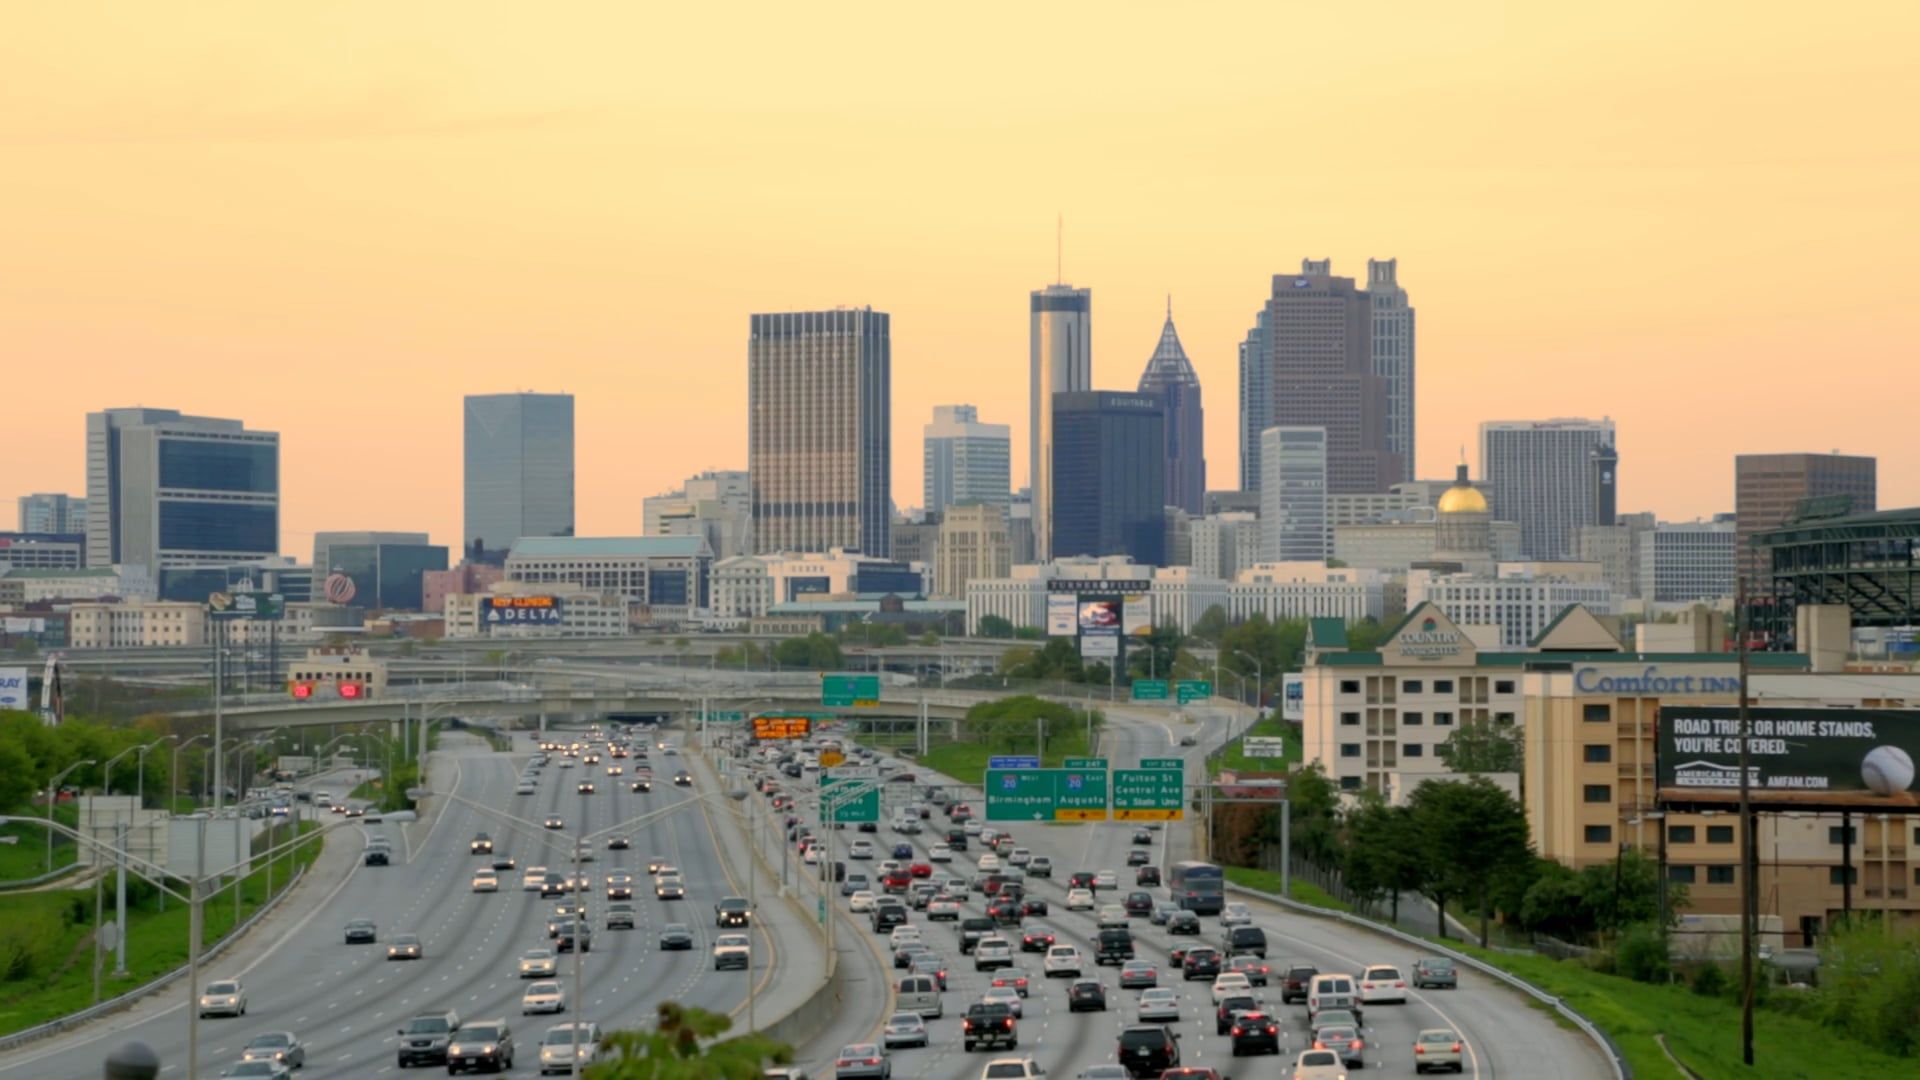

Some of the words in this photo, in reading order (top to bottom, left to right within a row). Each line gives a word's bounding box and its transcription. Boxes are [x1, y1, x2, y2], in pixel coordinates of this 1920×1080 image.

[1051, 581, 1099, 590] TURNER
[1110, 581, 1147, 590] FIELD
[504, 608, 560, 620] DELTA
[1400, 631, 1460, 643] COUNTRY
[1575, 665, 1695, 693] Comfort
[1701, 676, 1742, 692] INN
[1674, 719, 1710, 734] ROAD
[1754, 720, 1774, 736] OR
[1776, 721, 1817, 736] HOME
[1818, 721, 1876, 739] STANDS,
[1674, 738, 1721, 753] YOU'RE
[1122, 773, 1157, 783] Fulton
[1162, 773, 1173, 782] St
[1676, 769, 1723, 777] AMERICAN
[1725, 770, 1759, 778] FALY
[1003, 779, 1017, 789] 20
[1069, 779, 1082, 788] 20
[1766, 776, 1828, 788] AMFAM.COM
[1115, 785, 1155, 794] Central
[1161, 785, 1180, 794] Ave
[988, 795, 1052, 806] Birmingham
[1060, 795, 1104, 806] Augusta
